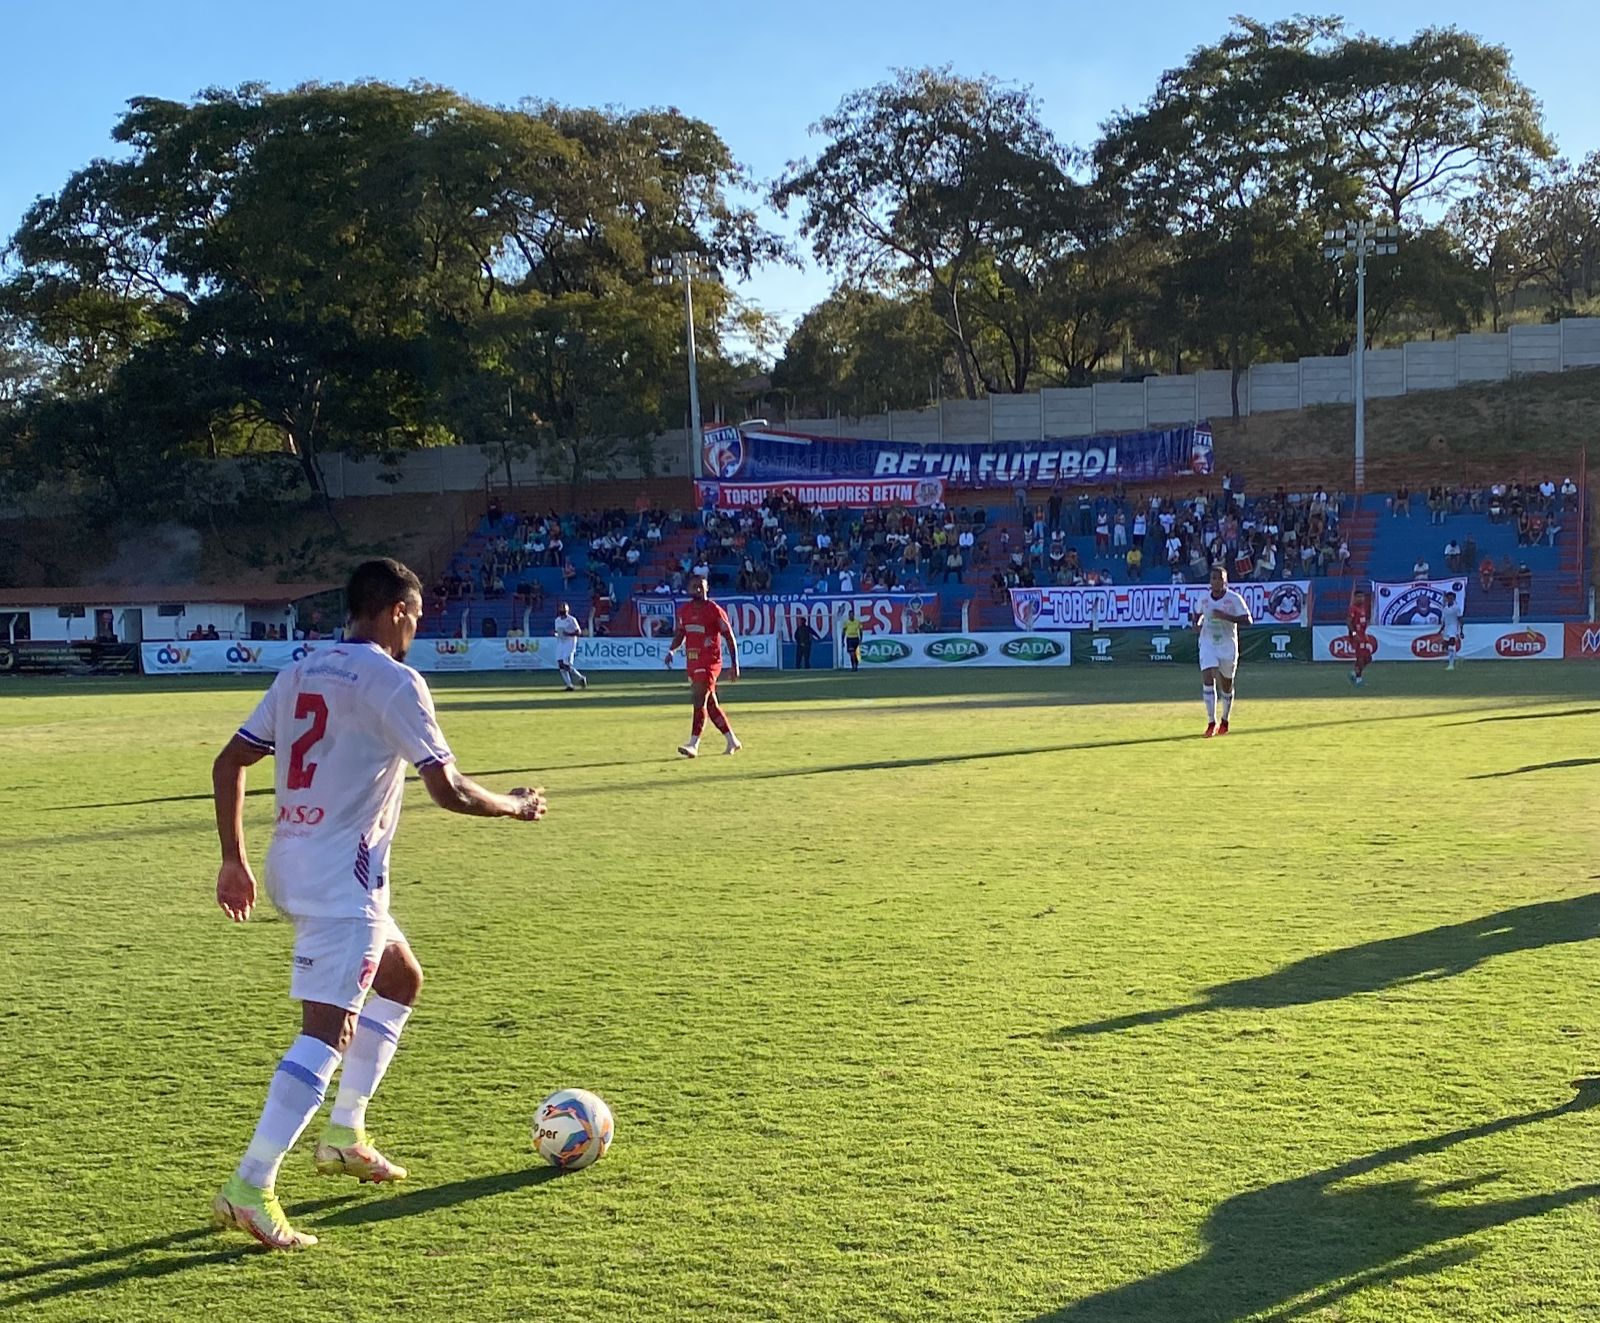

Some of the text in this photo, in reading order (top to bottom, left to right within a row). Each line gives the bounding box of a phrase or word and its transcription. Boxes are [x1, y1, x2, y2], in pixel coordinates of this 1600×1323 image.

[872, 484, 913, 502] BETIM
[755, 593, 808, 602] TORCIDA
[1049, 590, 1118, 623] TORCDA
[860, 644, 904, 657] SADA
[931, 642, 980, 655] SADA
[1007, 642, 1056, 654] SADA
[1500, 638, 1541, 652] Plena
[287, 692, 328, 790] 2
